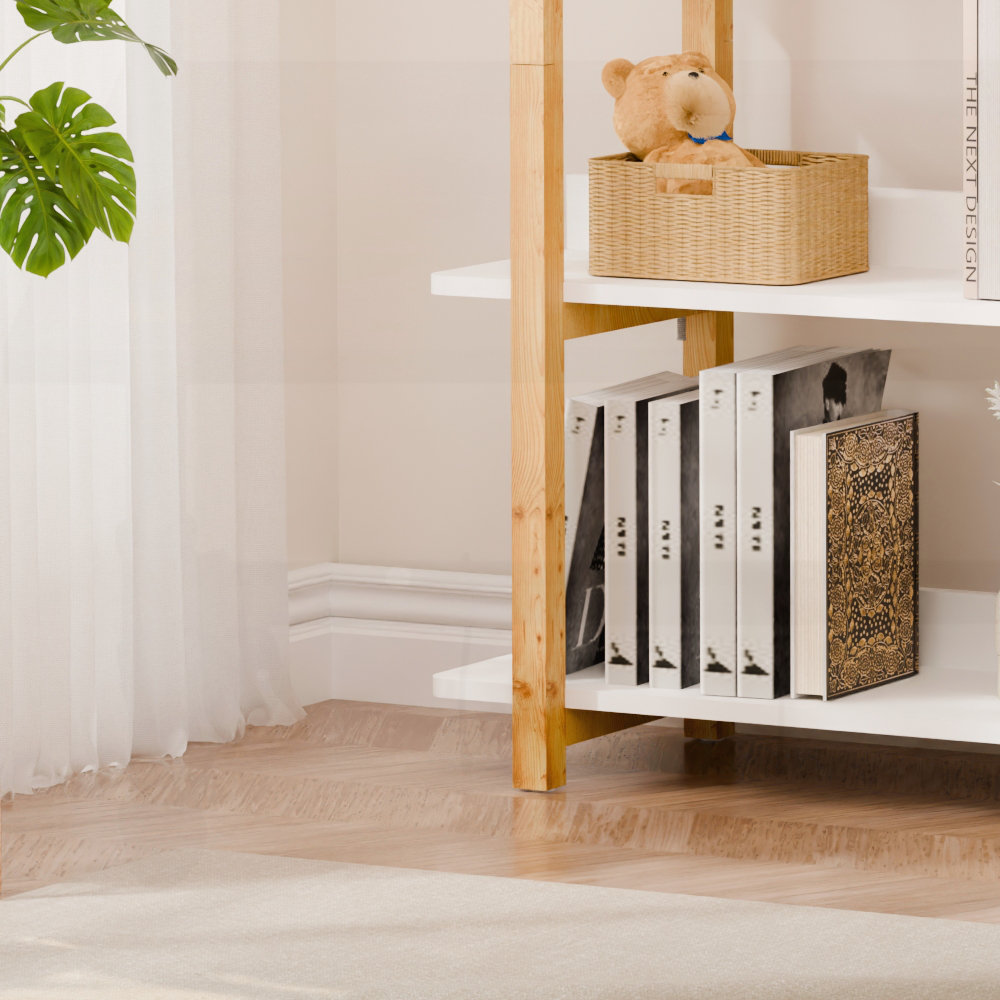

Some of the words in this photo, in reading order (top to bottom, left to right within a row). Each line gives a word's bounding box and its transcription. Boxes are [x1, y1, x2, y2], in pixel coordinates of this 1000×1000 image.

[966, 72, 977, 117] THE
[966, 126, 977, 187] NEXT
[965, 196, 977, 282] DESIGN
